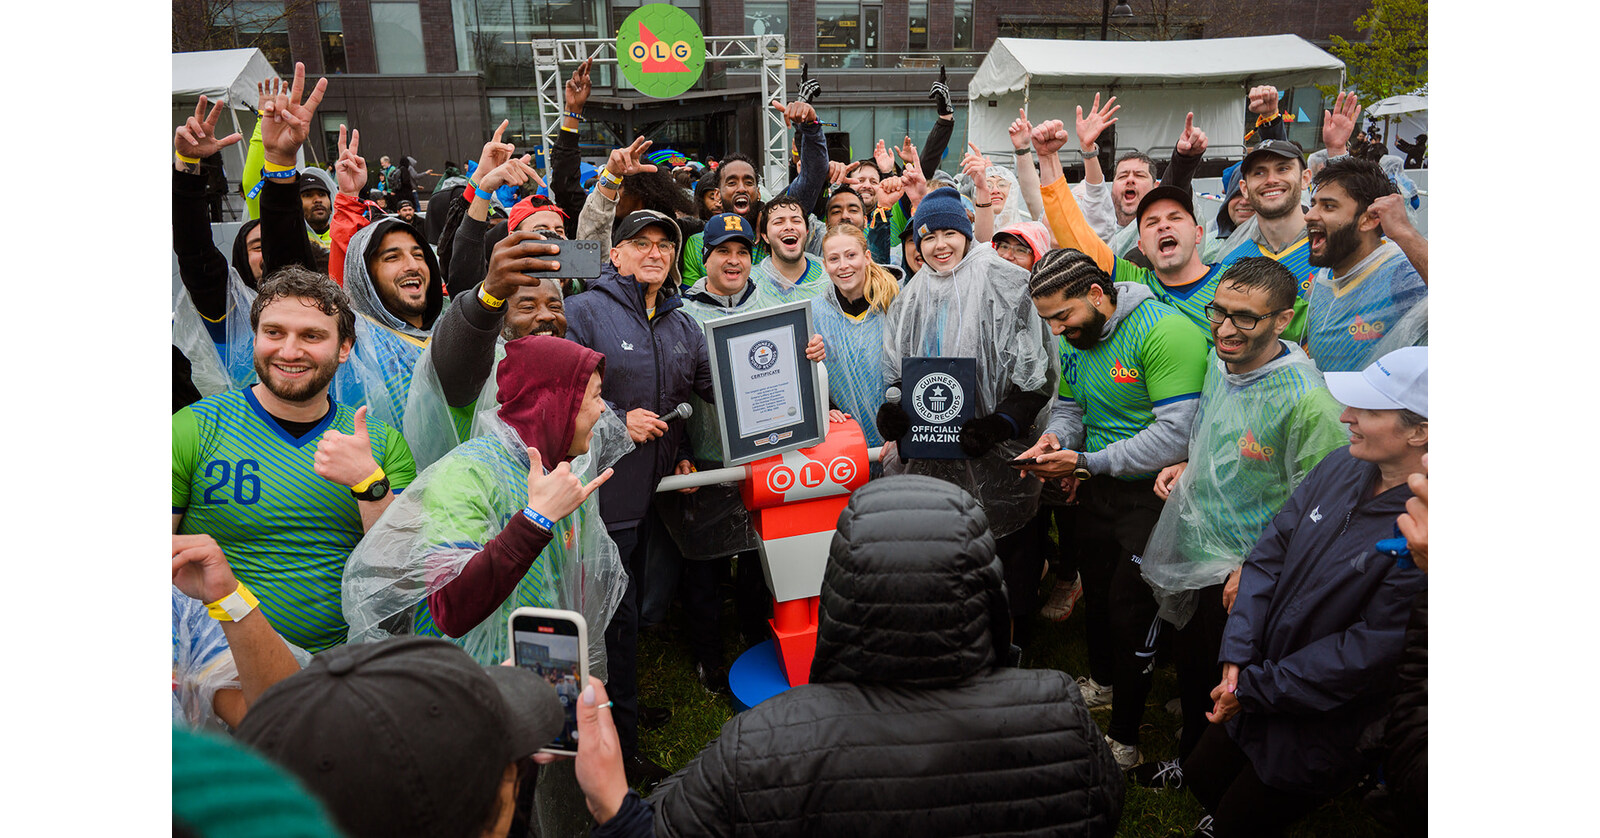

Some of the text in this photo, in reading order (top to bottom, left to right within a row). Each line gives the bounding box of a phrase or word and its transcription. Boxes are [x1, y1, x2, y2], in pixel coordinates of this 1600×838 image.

[632, 44, 688, 59] OLG
[723, 215, 743, 231] H
[1350, 322, 1384, 334] OLG
[752, 342, 774, 353] GUINNESS
[750, 350, 777, 369] WORLD RECORDS
[750, 369, 780, 380] CERTIFICATE
[1110, 368, 1138, 378] OLG
[920, 376, 957, 390] GUINNESS
[916, 395, 961, 420] WORLD RECORDS
[911, 425, 962, 433] OFFICIALLY
[1239, 439, 1273, 455] OLG
[204, 459, 261, 505] 26
[772, 462, 852, 489] OLG
